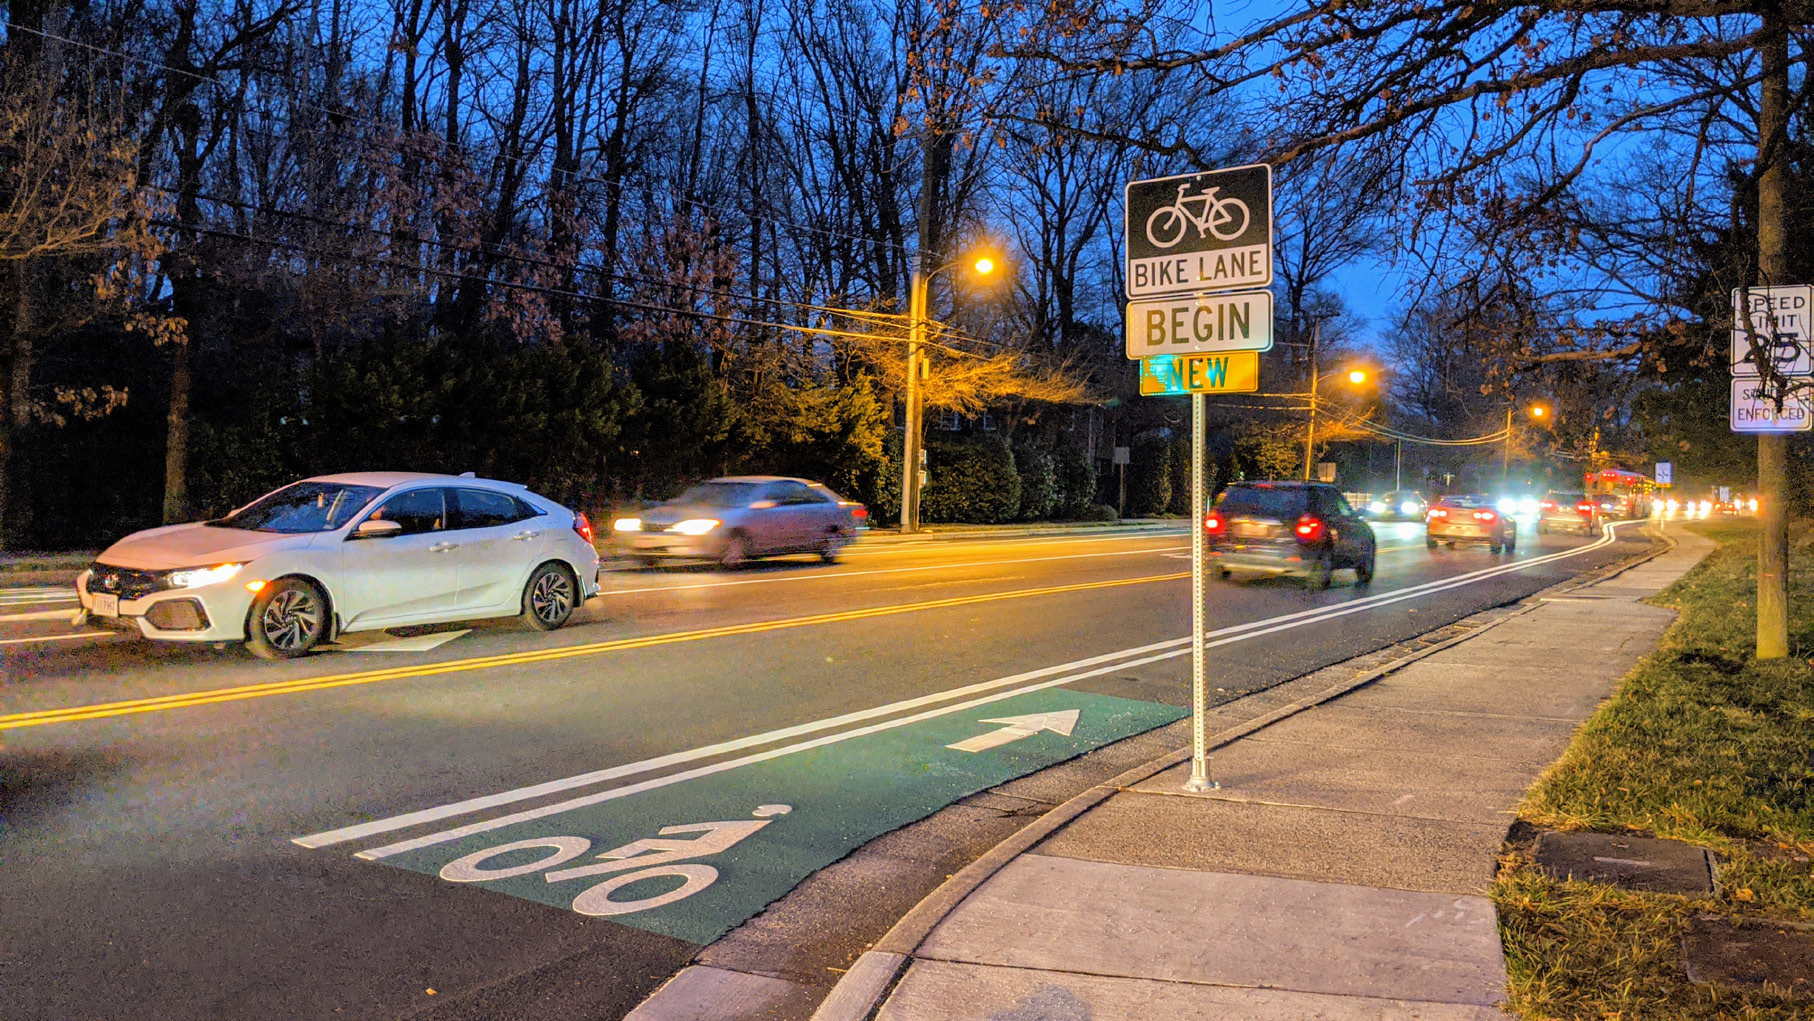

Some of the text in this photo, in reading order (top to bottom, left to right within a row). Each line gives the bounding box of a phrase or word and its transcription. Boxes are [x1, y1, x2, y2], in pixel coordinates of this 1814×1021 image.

[1135, 250, 1263, 288] BIKE LANE
[1741, 296, 1806, 313] PEED
[1146, 302, 1250, 346] BEGIN
[1165, 357, 1229, 389] NEW
[1738, 407, 1805, 421] ENFORCED
